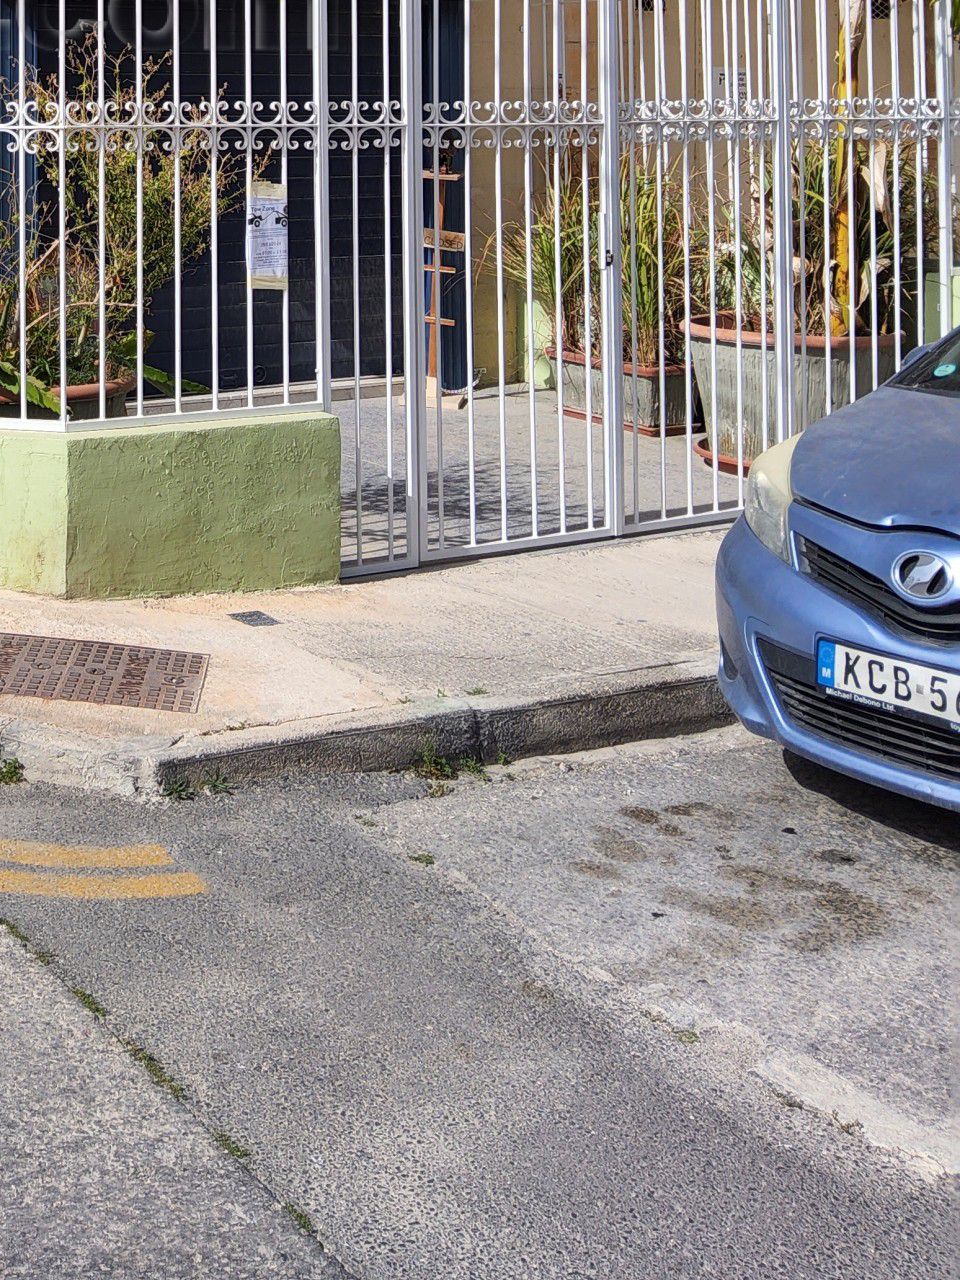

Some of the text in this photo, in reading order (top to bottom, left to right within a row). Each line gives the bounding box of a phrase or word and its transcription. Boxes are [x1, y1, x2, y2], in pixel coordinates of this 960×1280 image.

[424, 235, 464, 250] COSED
[843, 651, 960, 717] KCB 5
[825, 686, 853, 700] Michael
